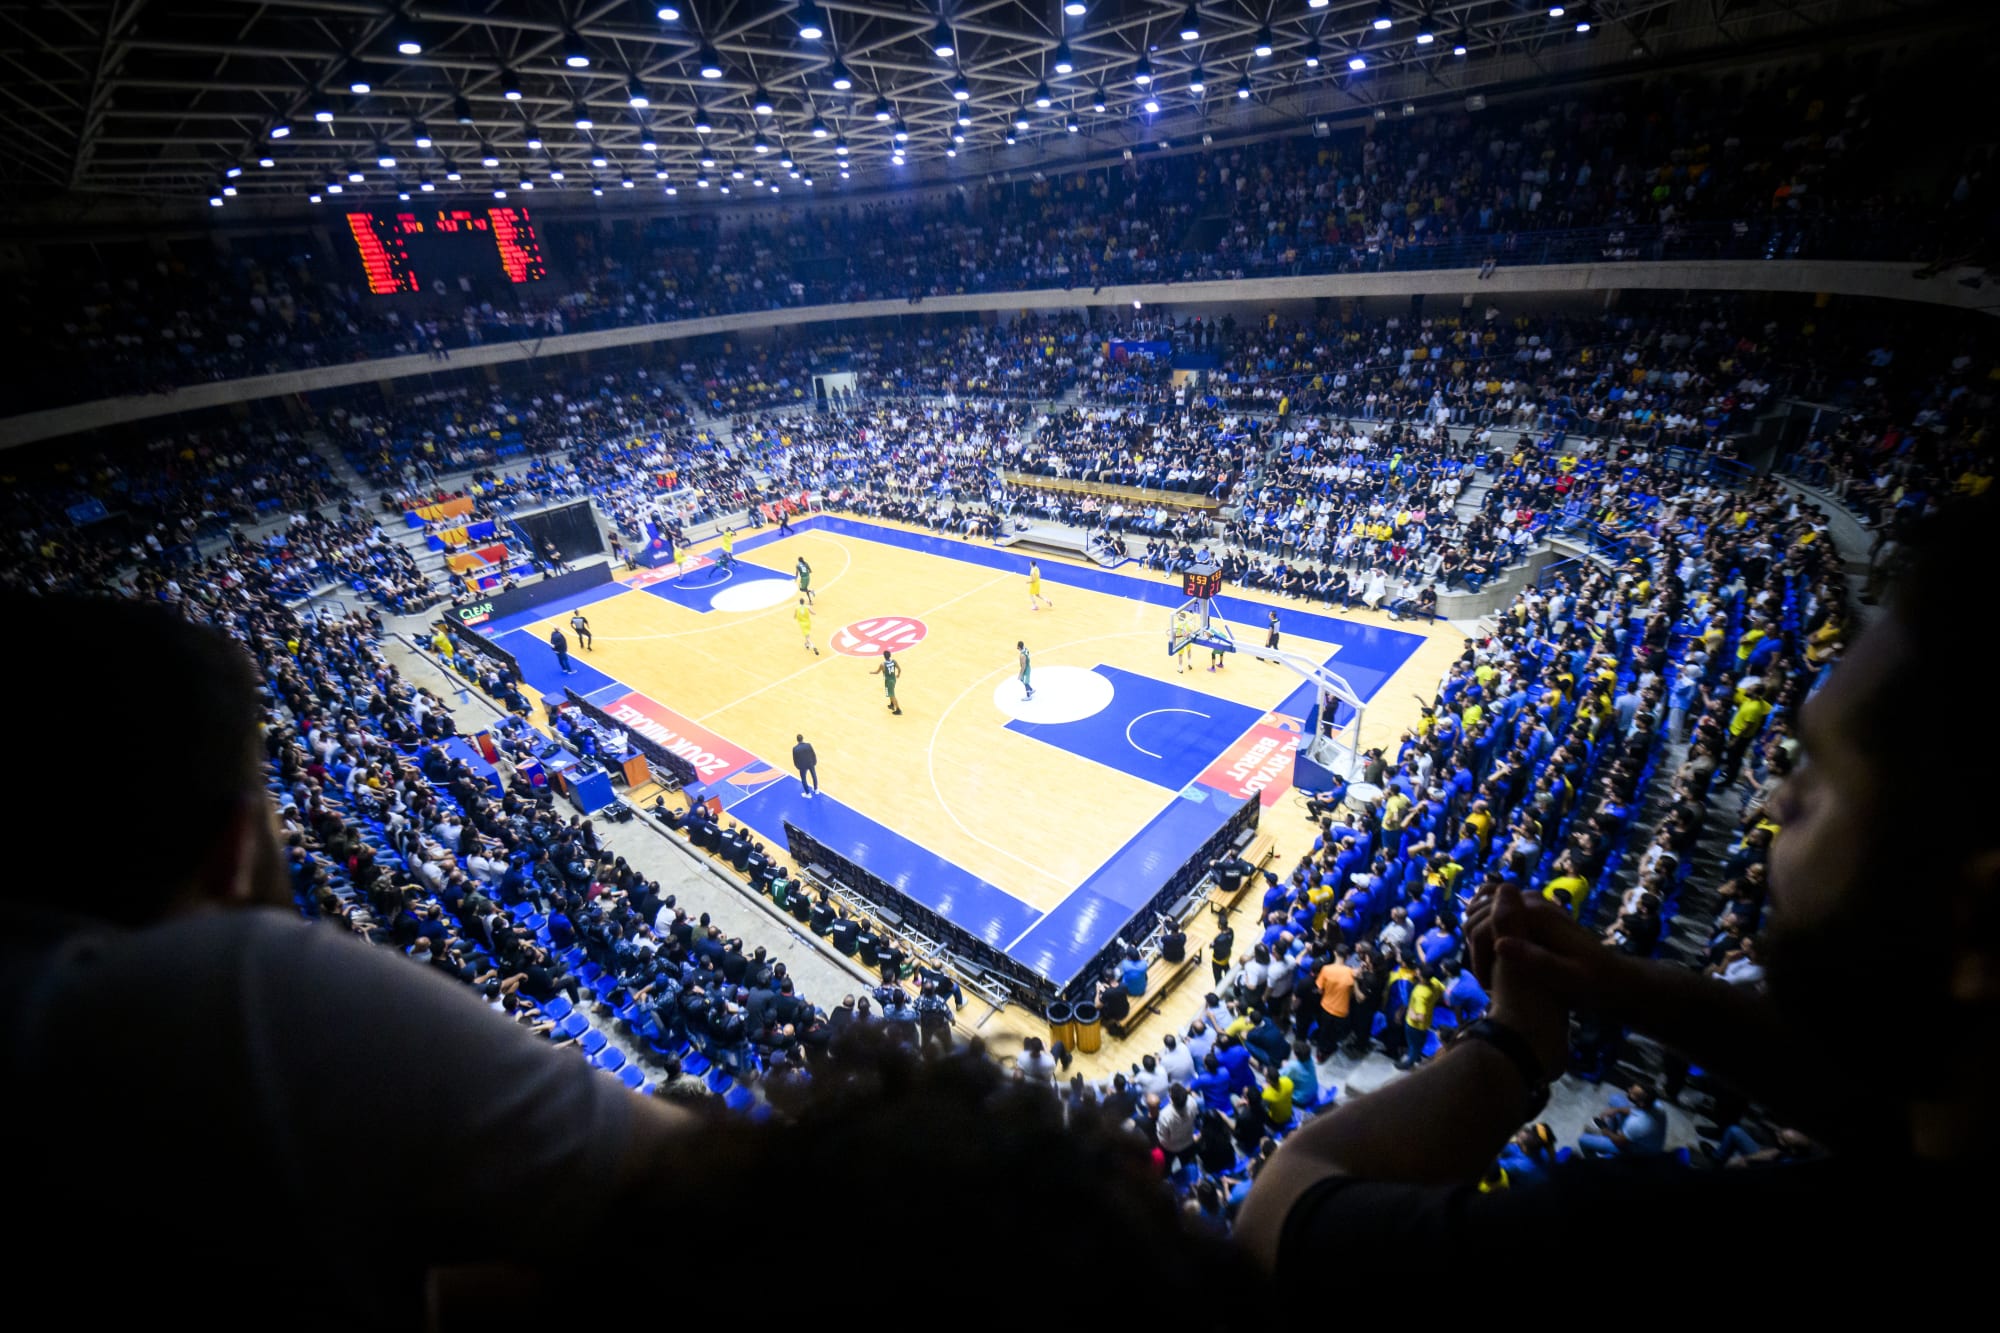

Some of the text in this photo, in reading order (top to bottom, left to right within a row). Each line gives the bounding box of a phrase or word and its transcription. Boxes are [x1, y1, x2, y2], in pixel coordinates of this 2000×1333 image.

[1187, 583, 1203, 597] 21
[459, 603, 494, 620] CLEAR
[666, 737, 730, 775] ZOUK
[1226, 736, 1280, 782] BEIRUT
[1239, 753, 1293, 796] RIYADI
